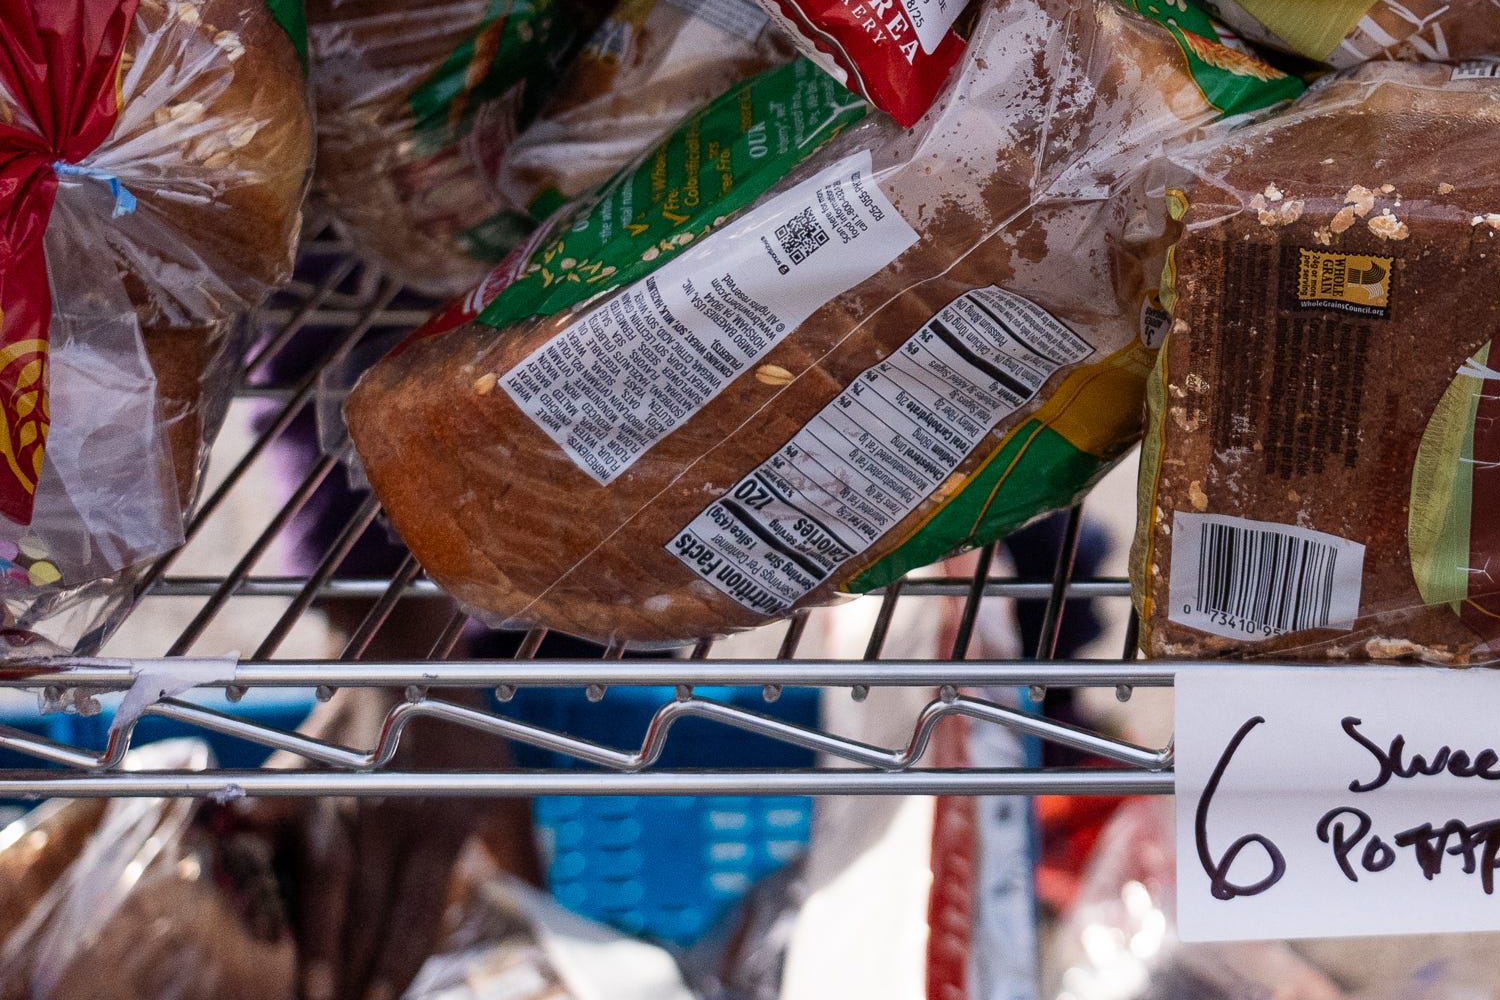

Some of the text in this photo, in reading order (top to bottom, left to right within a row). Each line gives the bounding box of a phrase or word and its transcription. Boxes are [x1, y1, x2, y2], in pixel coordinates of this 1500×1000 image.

[1299, 254, 1311, 296] per serving
[1308, 279, 1317, 297] more
[1311, 270, 1318, 278] or
[1318, 258, 1335, 295] GRAIN
[1330, 257, 1348, 297] WHOLE
[690, 292, 707, 311] USA,
[711, 278, 776, 341] www.brownberry.com
[721, 272, 780, 325] All rights reserved.
[1300, 300, 1384, 316] WholeGrainsCouncil.org
[703, 308, 738, 338] BAKERIES
[704, 292, 768, 350] HORSHAM, PA 19044
[733, 334, 758, 358] BIMBO
[507, 377, 532, 403] WHEAT
[517, 368, 541, 395] WHEAT
[891, 389, 913, 406] 21g
[535, 408, 561, 432] WHOLE
[540, 393, 572, 426] ENRICHED
[902, 399, 955, 441] Carbohydrate
[598, 445, 621, 472] FLOUR,
[886, 434, 946, 481] Cholesterol 0mg
[729, 476, 850, 565] Calories 120
[665, 531, 726, 576] Facts
[1181, 603, 1256, 635] 0 73410
[1194, 714, 1288, 901] 6
